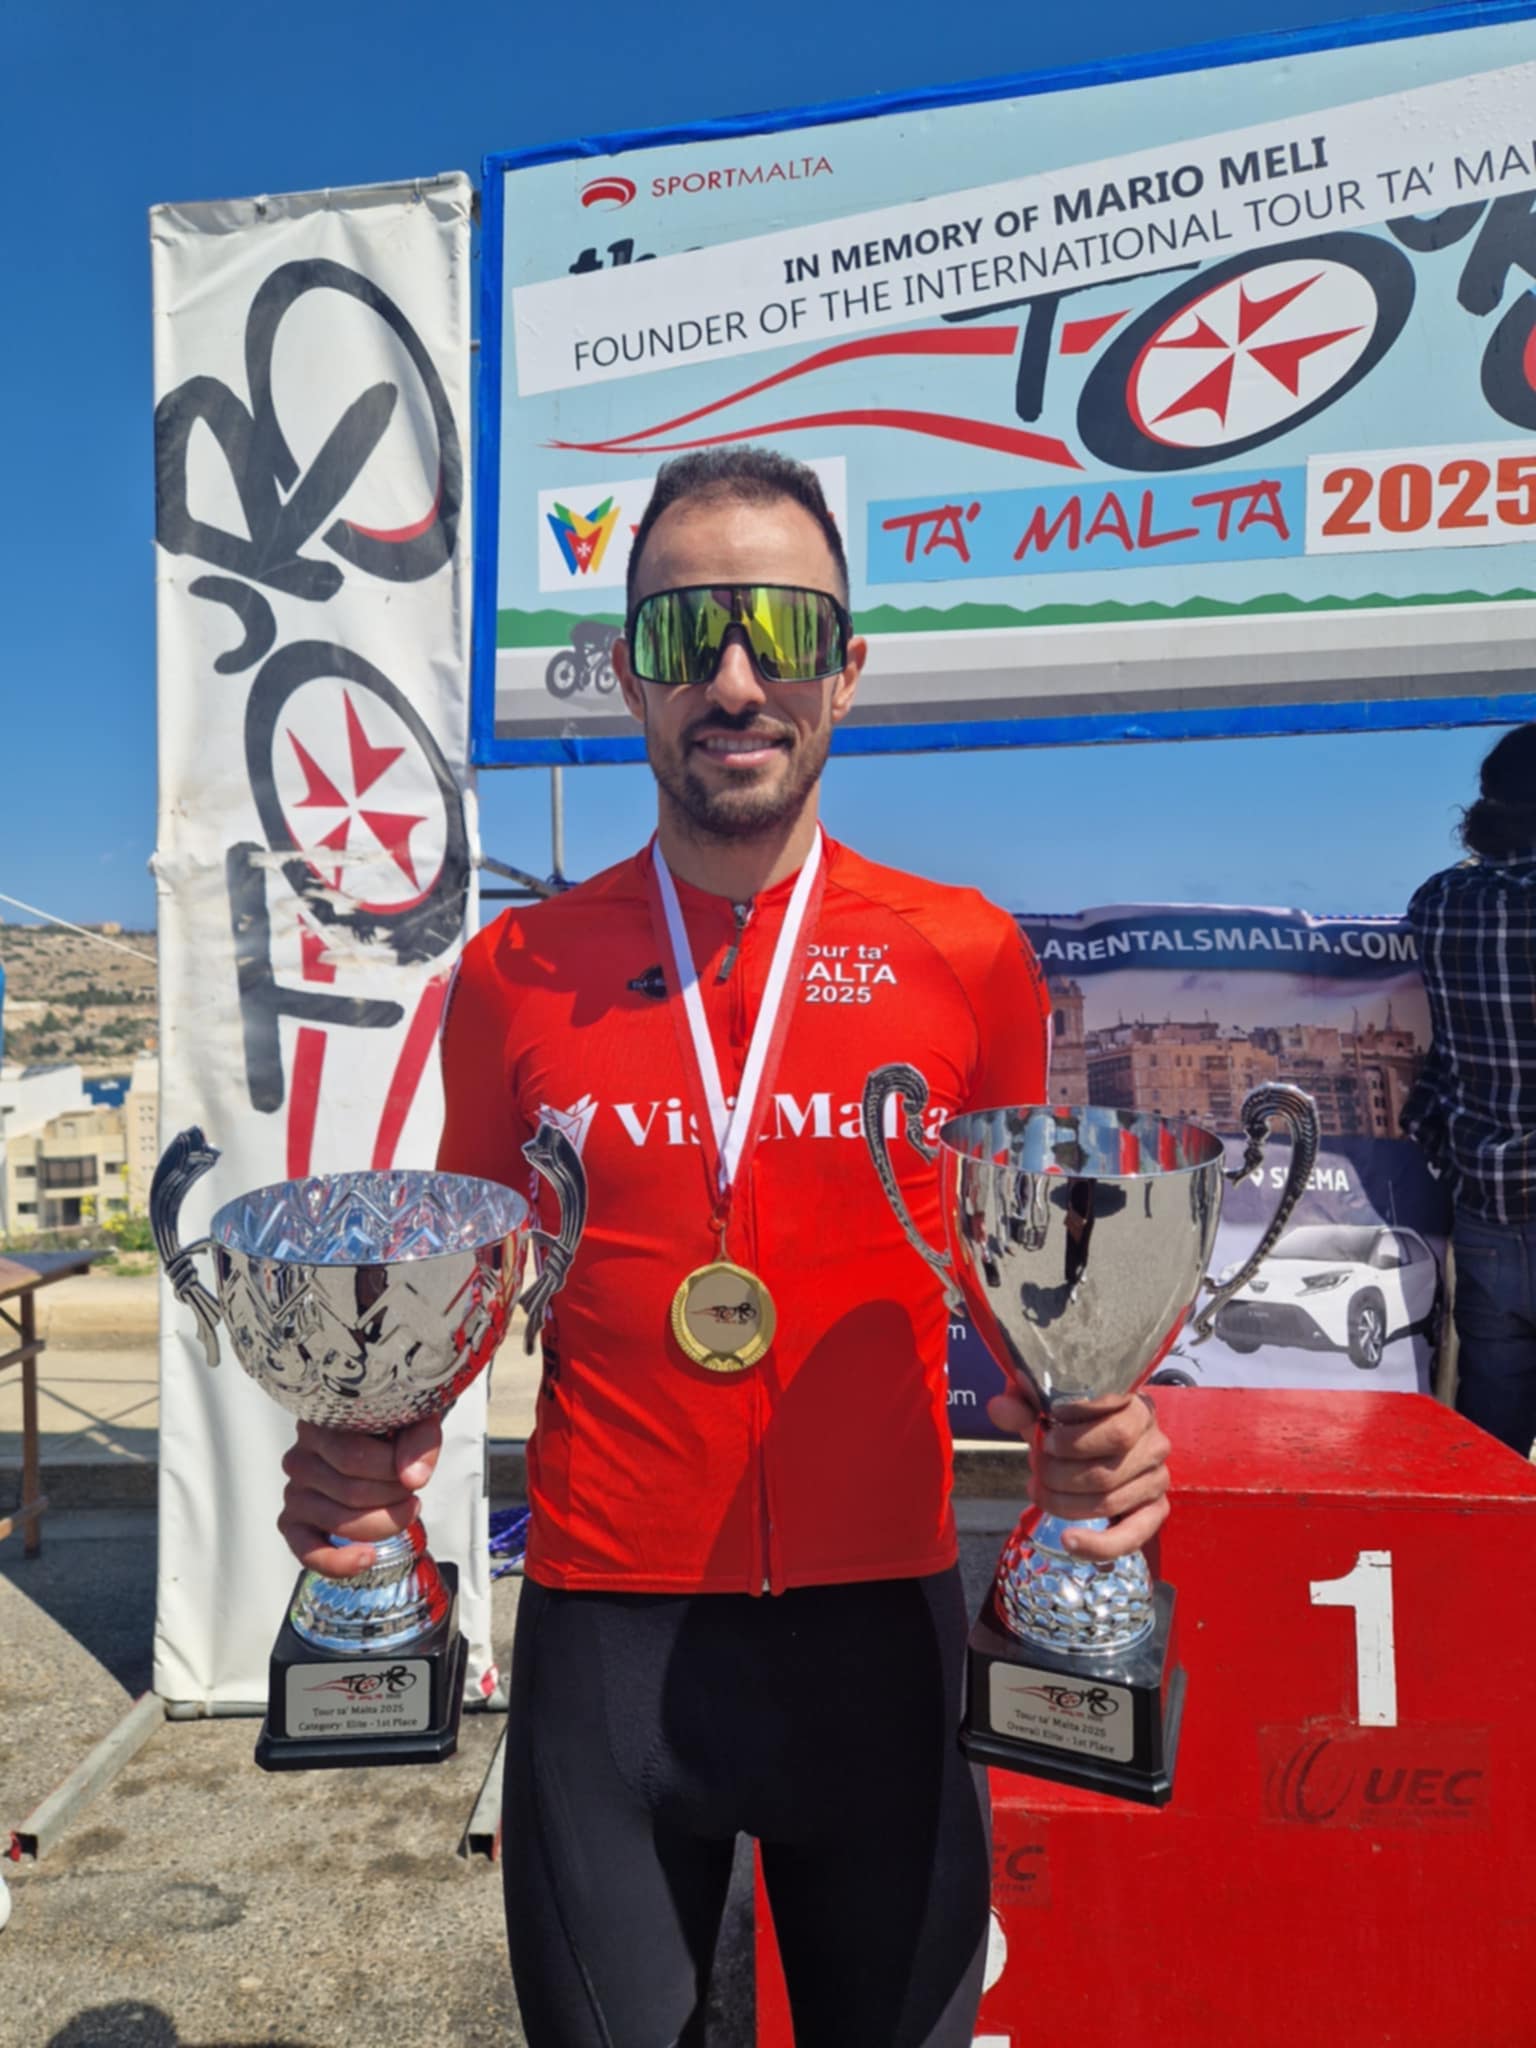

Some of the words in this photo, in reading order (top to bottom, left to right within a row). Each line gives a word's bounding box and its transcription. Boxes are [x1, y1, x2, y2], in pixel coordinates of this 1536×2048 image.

[651, 156, 833, 198] SPORTMALTA
[784, 253, 820, 284] IN
[831, 218, 983, 275] MEMORY
[994, 205, 1039, 238] OF
[1052, 164, 1204, 227] MARIO
[1219, 136, 1329, 189] MELI
[573, 311, 746, 371] FOUNDER
[760, 298, 808, 334] OF
[819, 285, 892, 322] THE
[904, 208, 1232, 306] INTERNATIONAL
[1244, 179, 1366, 232] TOUR
[1454, 139, 1536, 190] MA
[1013, 480, 1291, 562] MALTA
[1321, 456, 1536, 537] 2025
[807, 944, 848, 959] our
[1035, 926, 1419, 962] ARENTALSMALTA.COM
[802, 961, 897, 984] ALTA
[805, 985, 872, 1003] 2025
[1310, 1550, 1397, 1727] 1
[312, 1707, 335, 1717] Tour
[351, 1705, 378, 1714] Malta
[380, 1704, 404, 1713] 2025
[346, 1719, 367, 1729] Elite
[376, 1719, 391, 1727] 1st
[393, 1718, 417, 1727] Place
[1014, 1709, 1036, 1721] Tour
[1052, 1717, 1080, 1731] Malta
[1081, 1724, 1107, 1737] 2025
[1042, 1730, 1064, 1741] Elite
[1088, 1741, 1115, 1754] Place
[1361, 1766, 1484, 1807] UEC
